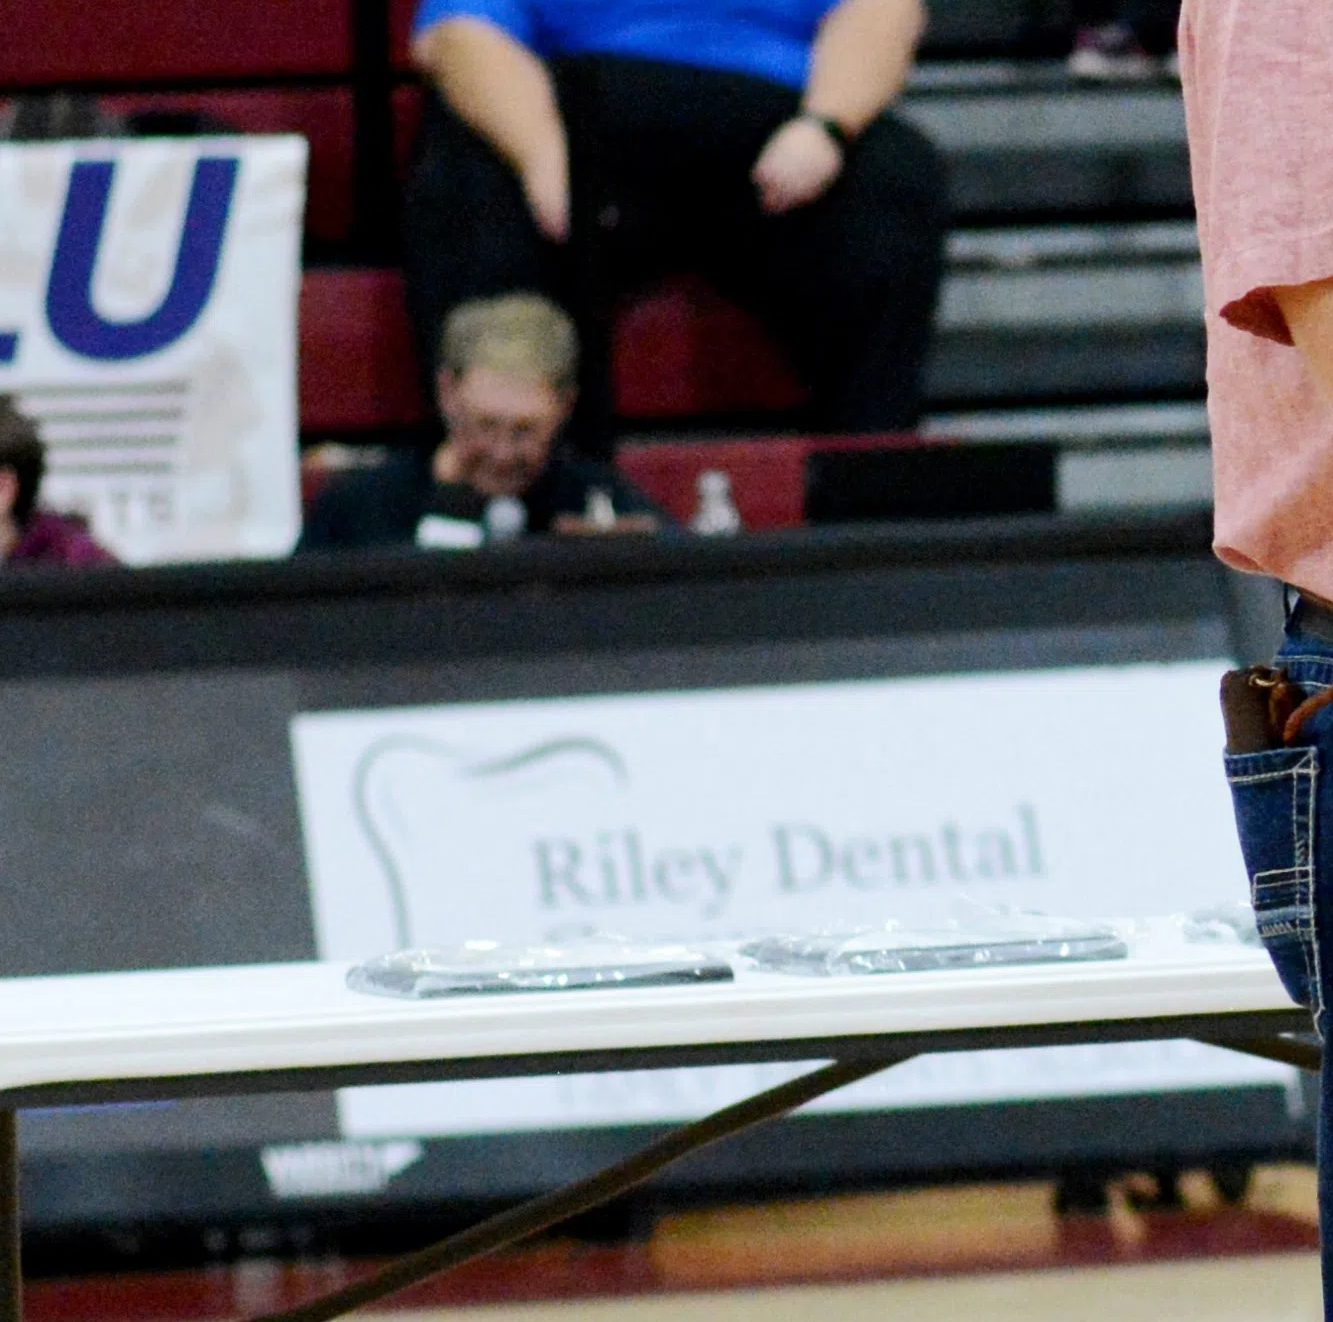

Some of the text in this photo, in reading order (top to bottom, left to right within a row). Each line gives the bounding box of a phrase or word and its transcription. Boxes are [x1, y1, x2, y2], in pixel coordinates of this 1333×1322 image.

[0, 157, 241, 364] U
[532, 800, 1046, 920] Riley Dental
